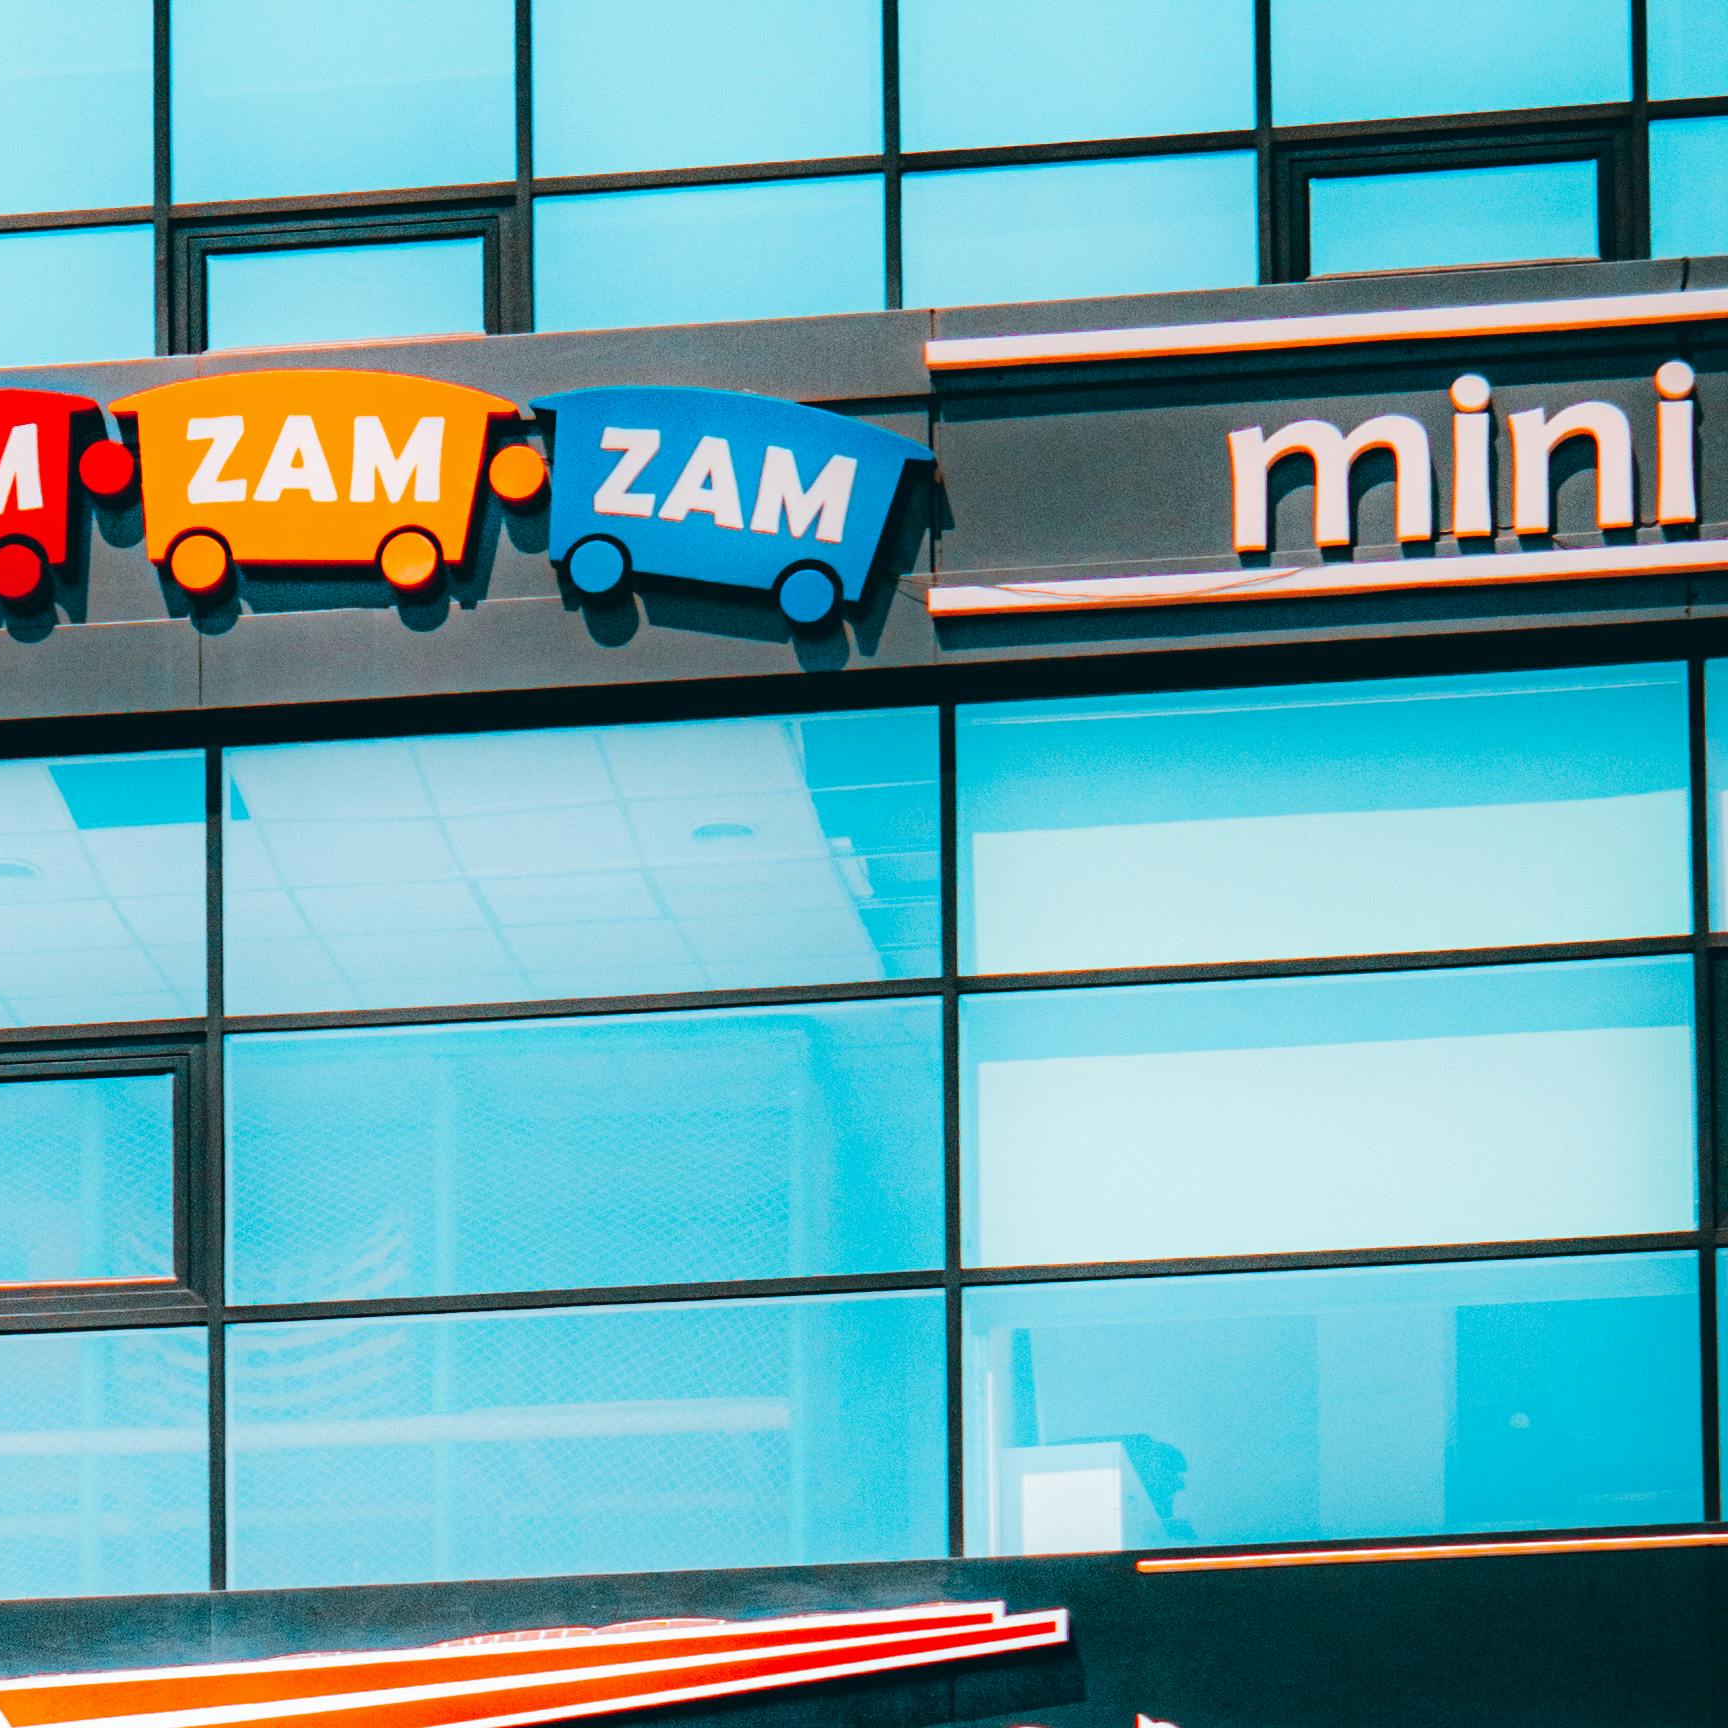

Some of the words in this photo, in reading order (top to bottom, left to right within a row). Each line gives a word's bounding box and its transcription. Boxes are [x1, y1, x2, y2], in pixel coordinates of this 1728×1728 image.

[186, 415, 446, 505] ZAM
[593, 426, 859, 544] ZAM
[1228, 360, 1697, 553] mini
